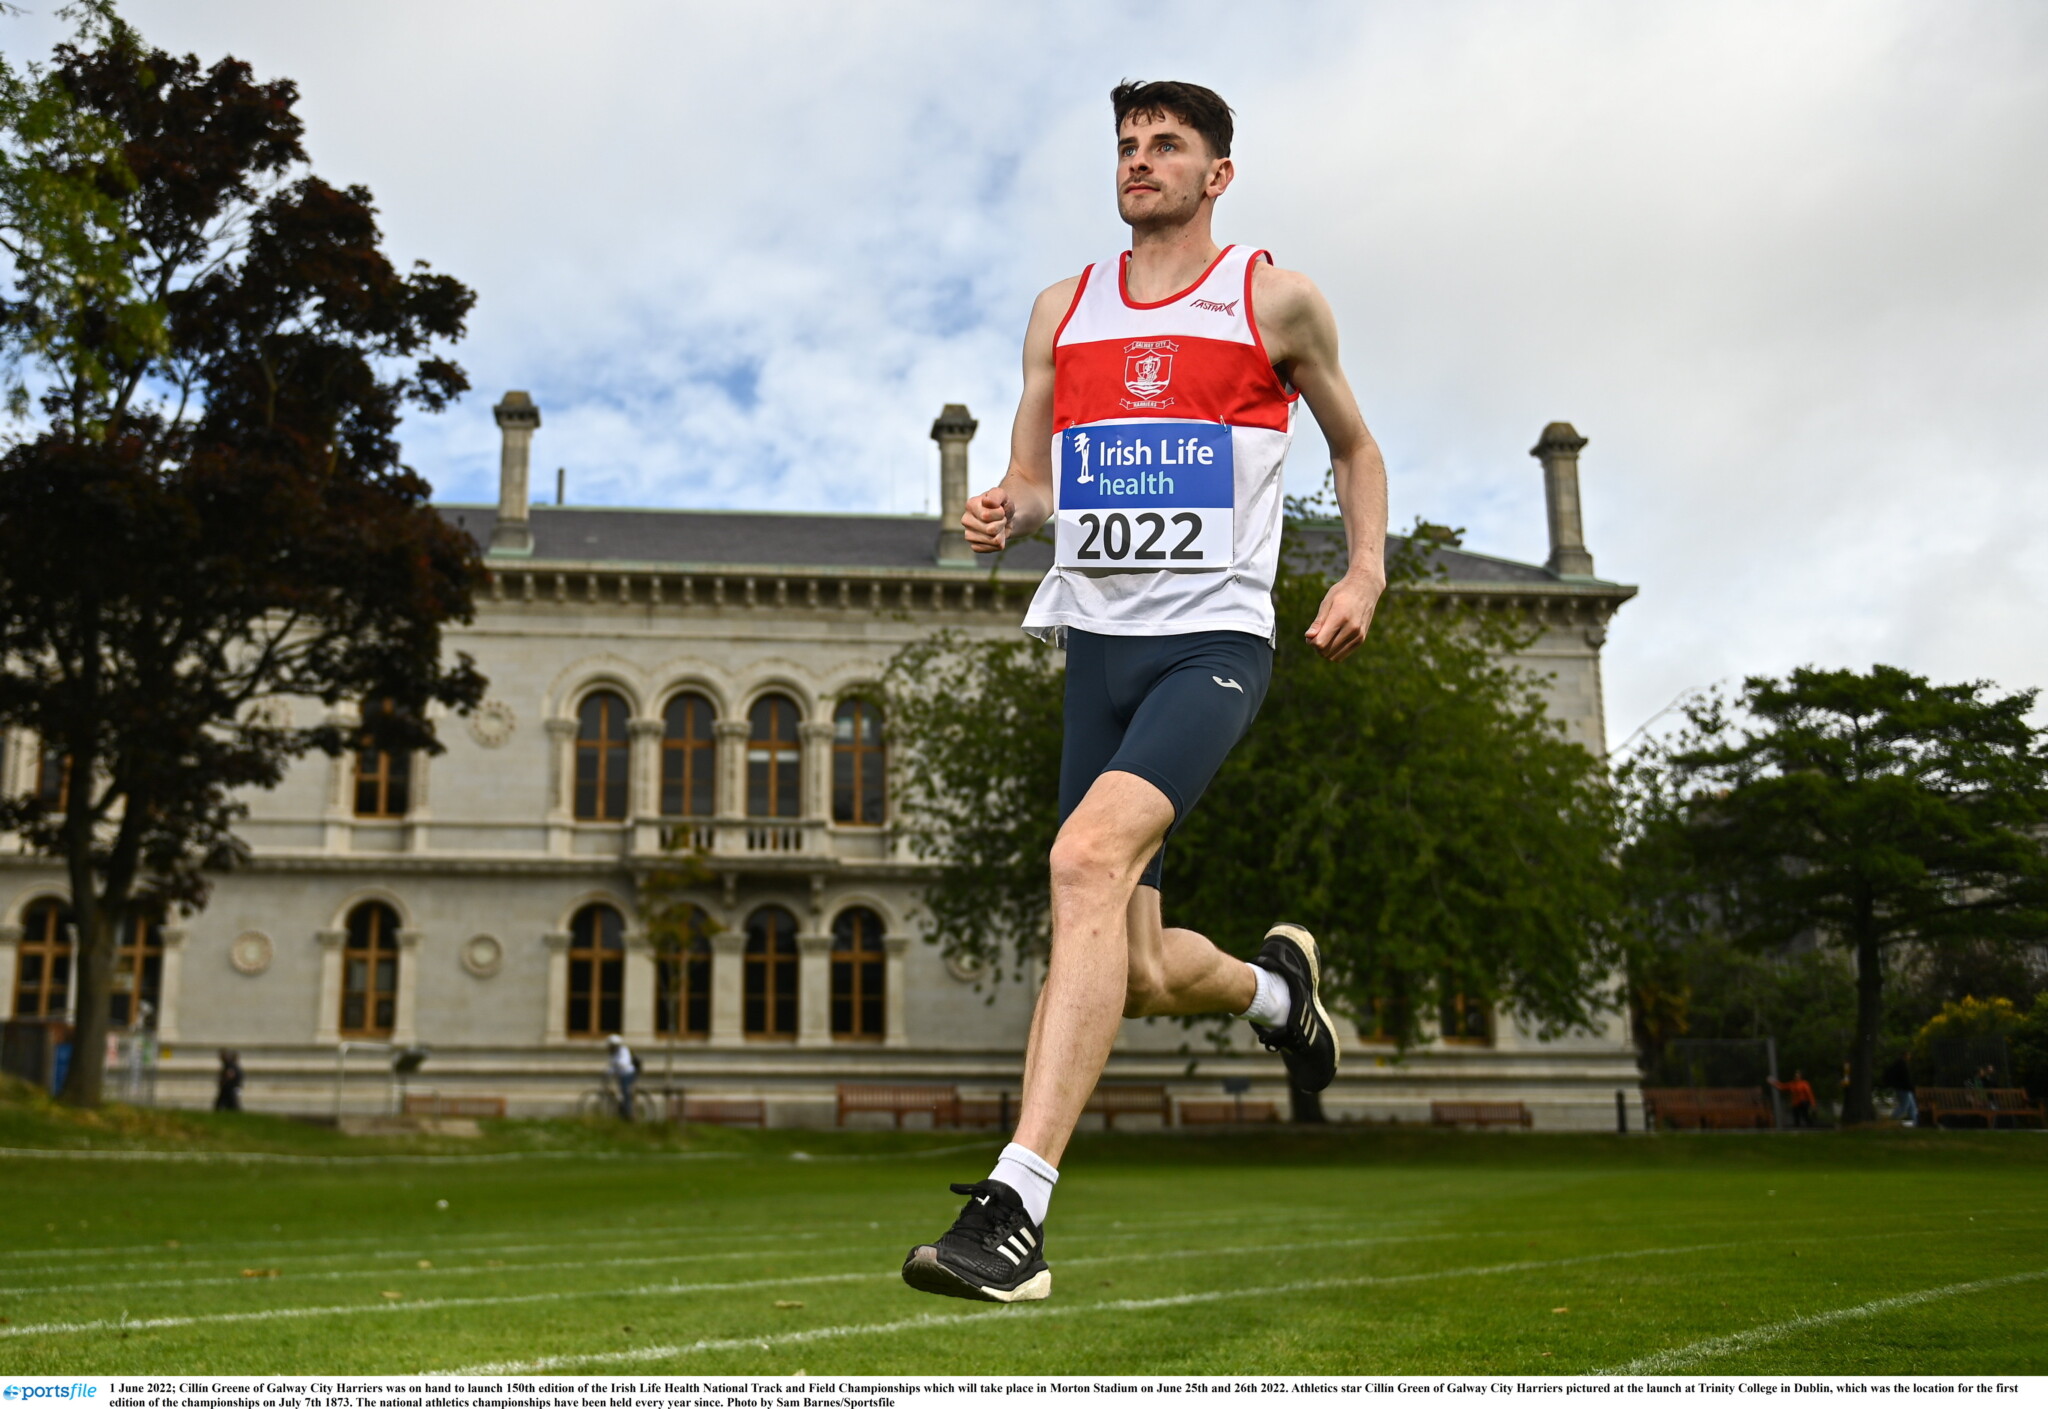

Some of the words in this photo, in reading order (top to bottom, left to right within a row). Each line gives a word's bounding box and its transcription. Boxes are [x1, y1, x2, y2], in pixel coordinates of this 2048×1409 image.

[1099, 438, 1152, 467] Irish
[1160, 437, 1214, 466] Life
[1099, 470, 1175, 496] health
[1077, 512, 1204, 561] 2022
